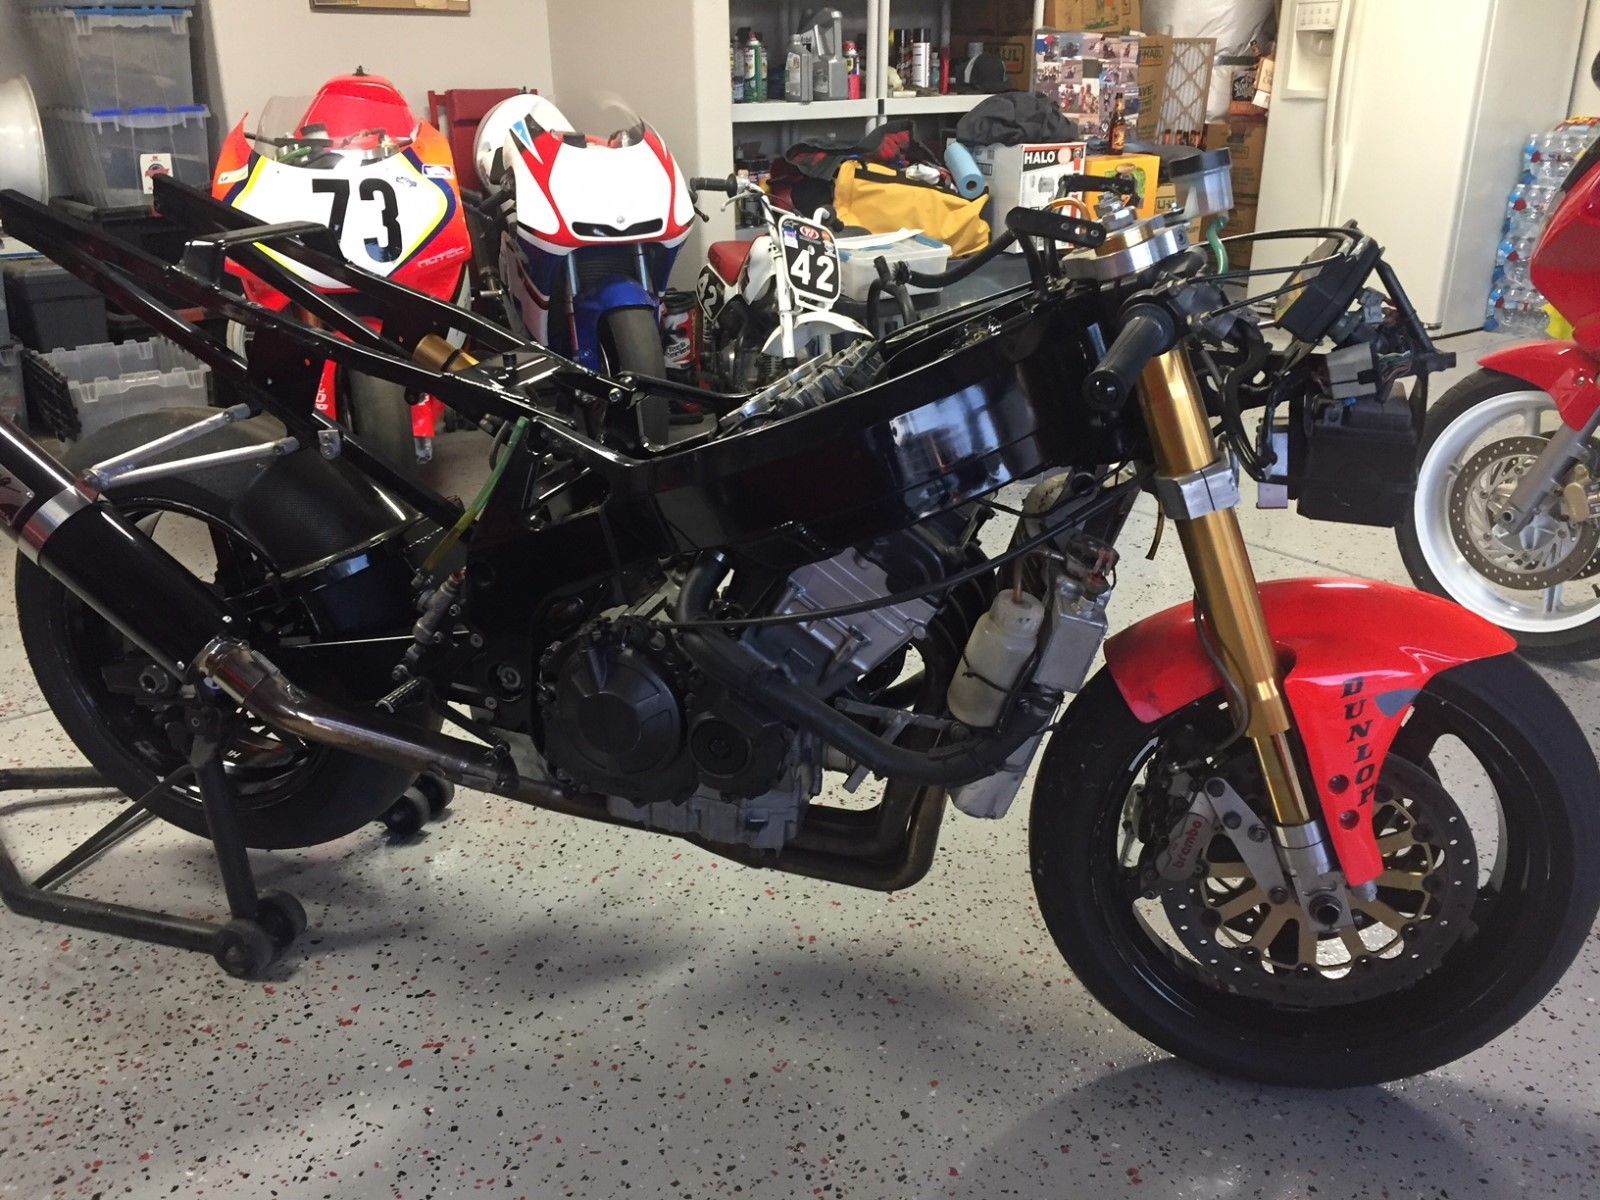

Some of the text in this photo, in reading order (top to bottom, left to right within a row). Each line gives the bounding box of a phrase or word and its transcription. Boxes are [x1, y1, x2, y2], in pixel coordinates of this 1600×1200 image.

[1024, 150, 1056, 165] HALO
[312, 178, 403, 263] 73
[790, 248, 835, 293] 42
[1340, 675, 1377, 807] DUNLOP
[1172, 820, 1203, 869] brembo
